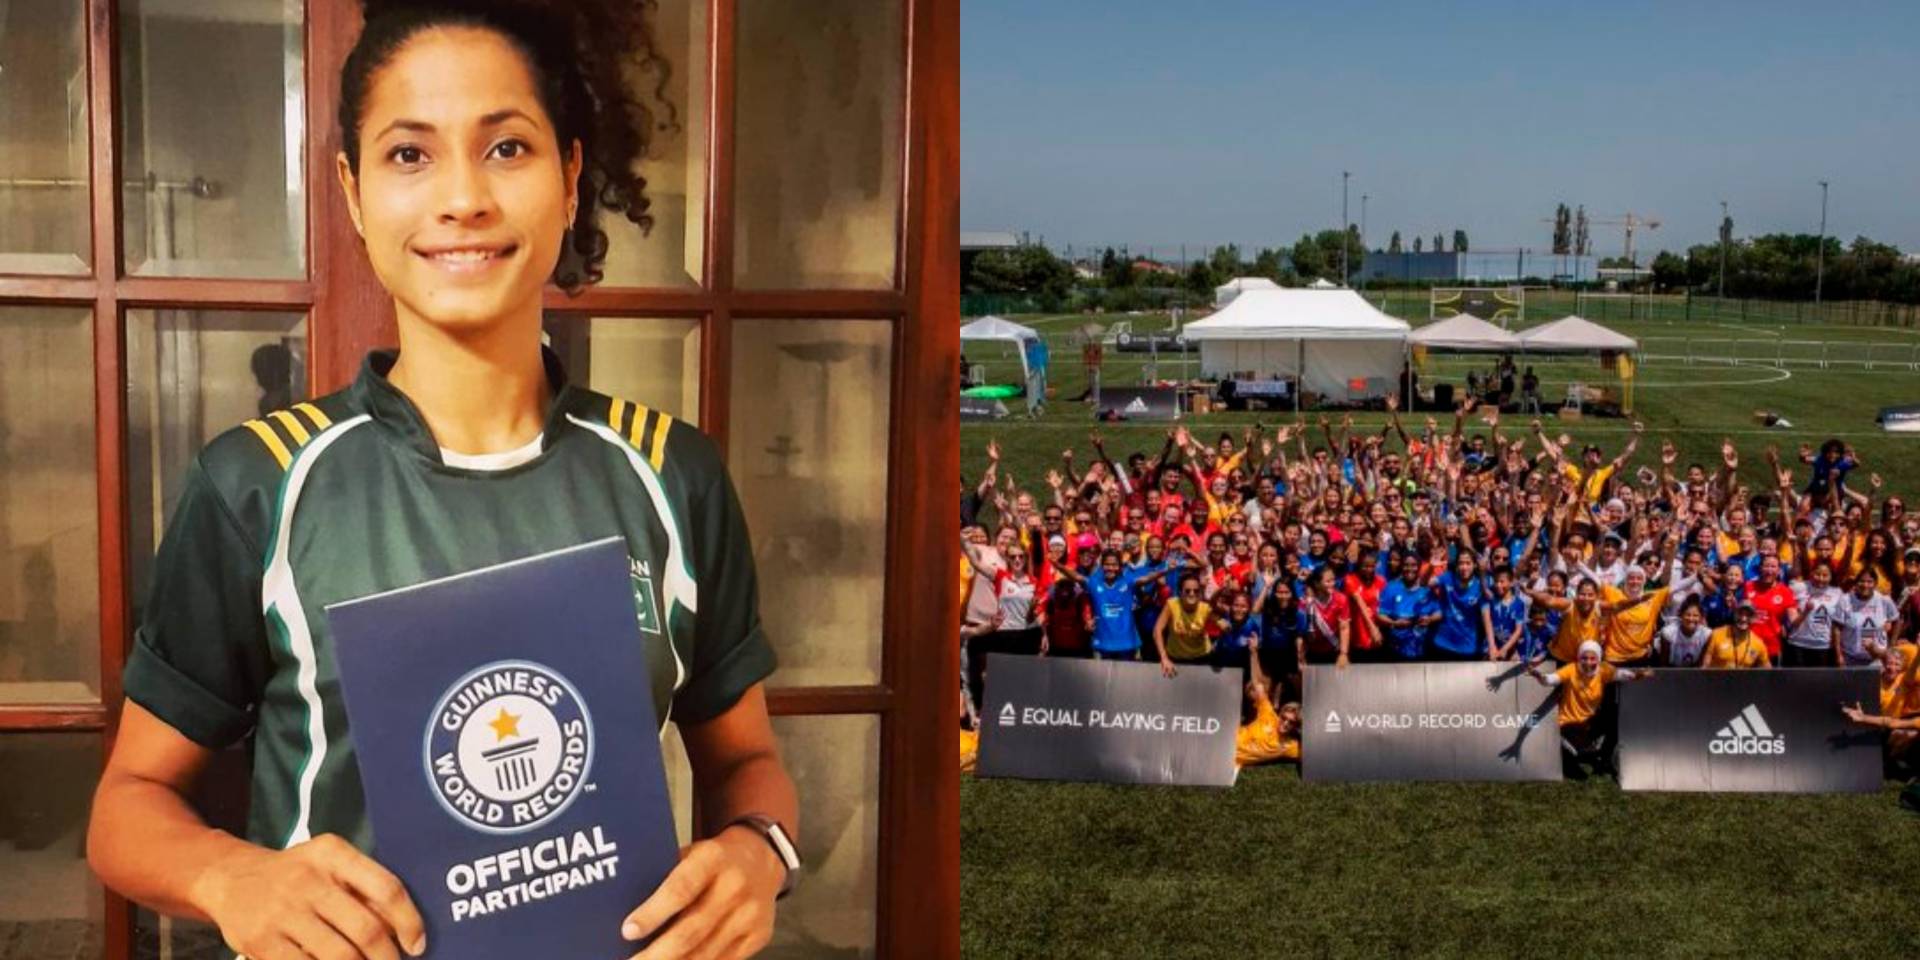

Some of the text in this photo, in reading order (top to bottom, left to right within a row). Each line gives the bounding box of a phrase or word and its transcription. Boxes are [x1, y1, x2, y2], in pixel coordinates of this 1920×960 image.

[442, 671, 563, 731] GUINNESS
[1022, 707, 1220, 734] EQUAL PLAYING FIELD
[1347, 714, 1539, 729] WORLD RECORD GAME
[434, 718, 584, 823] WORLD RECORDS
[1709, 735, 1785, 754] adidas
[446, 826, 617, 895] OFFICIAL
[451, 856, 619, 921] PARTICIPANT
